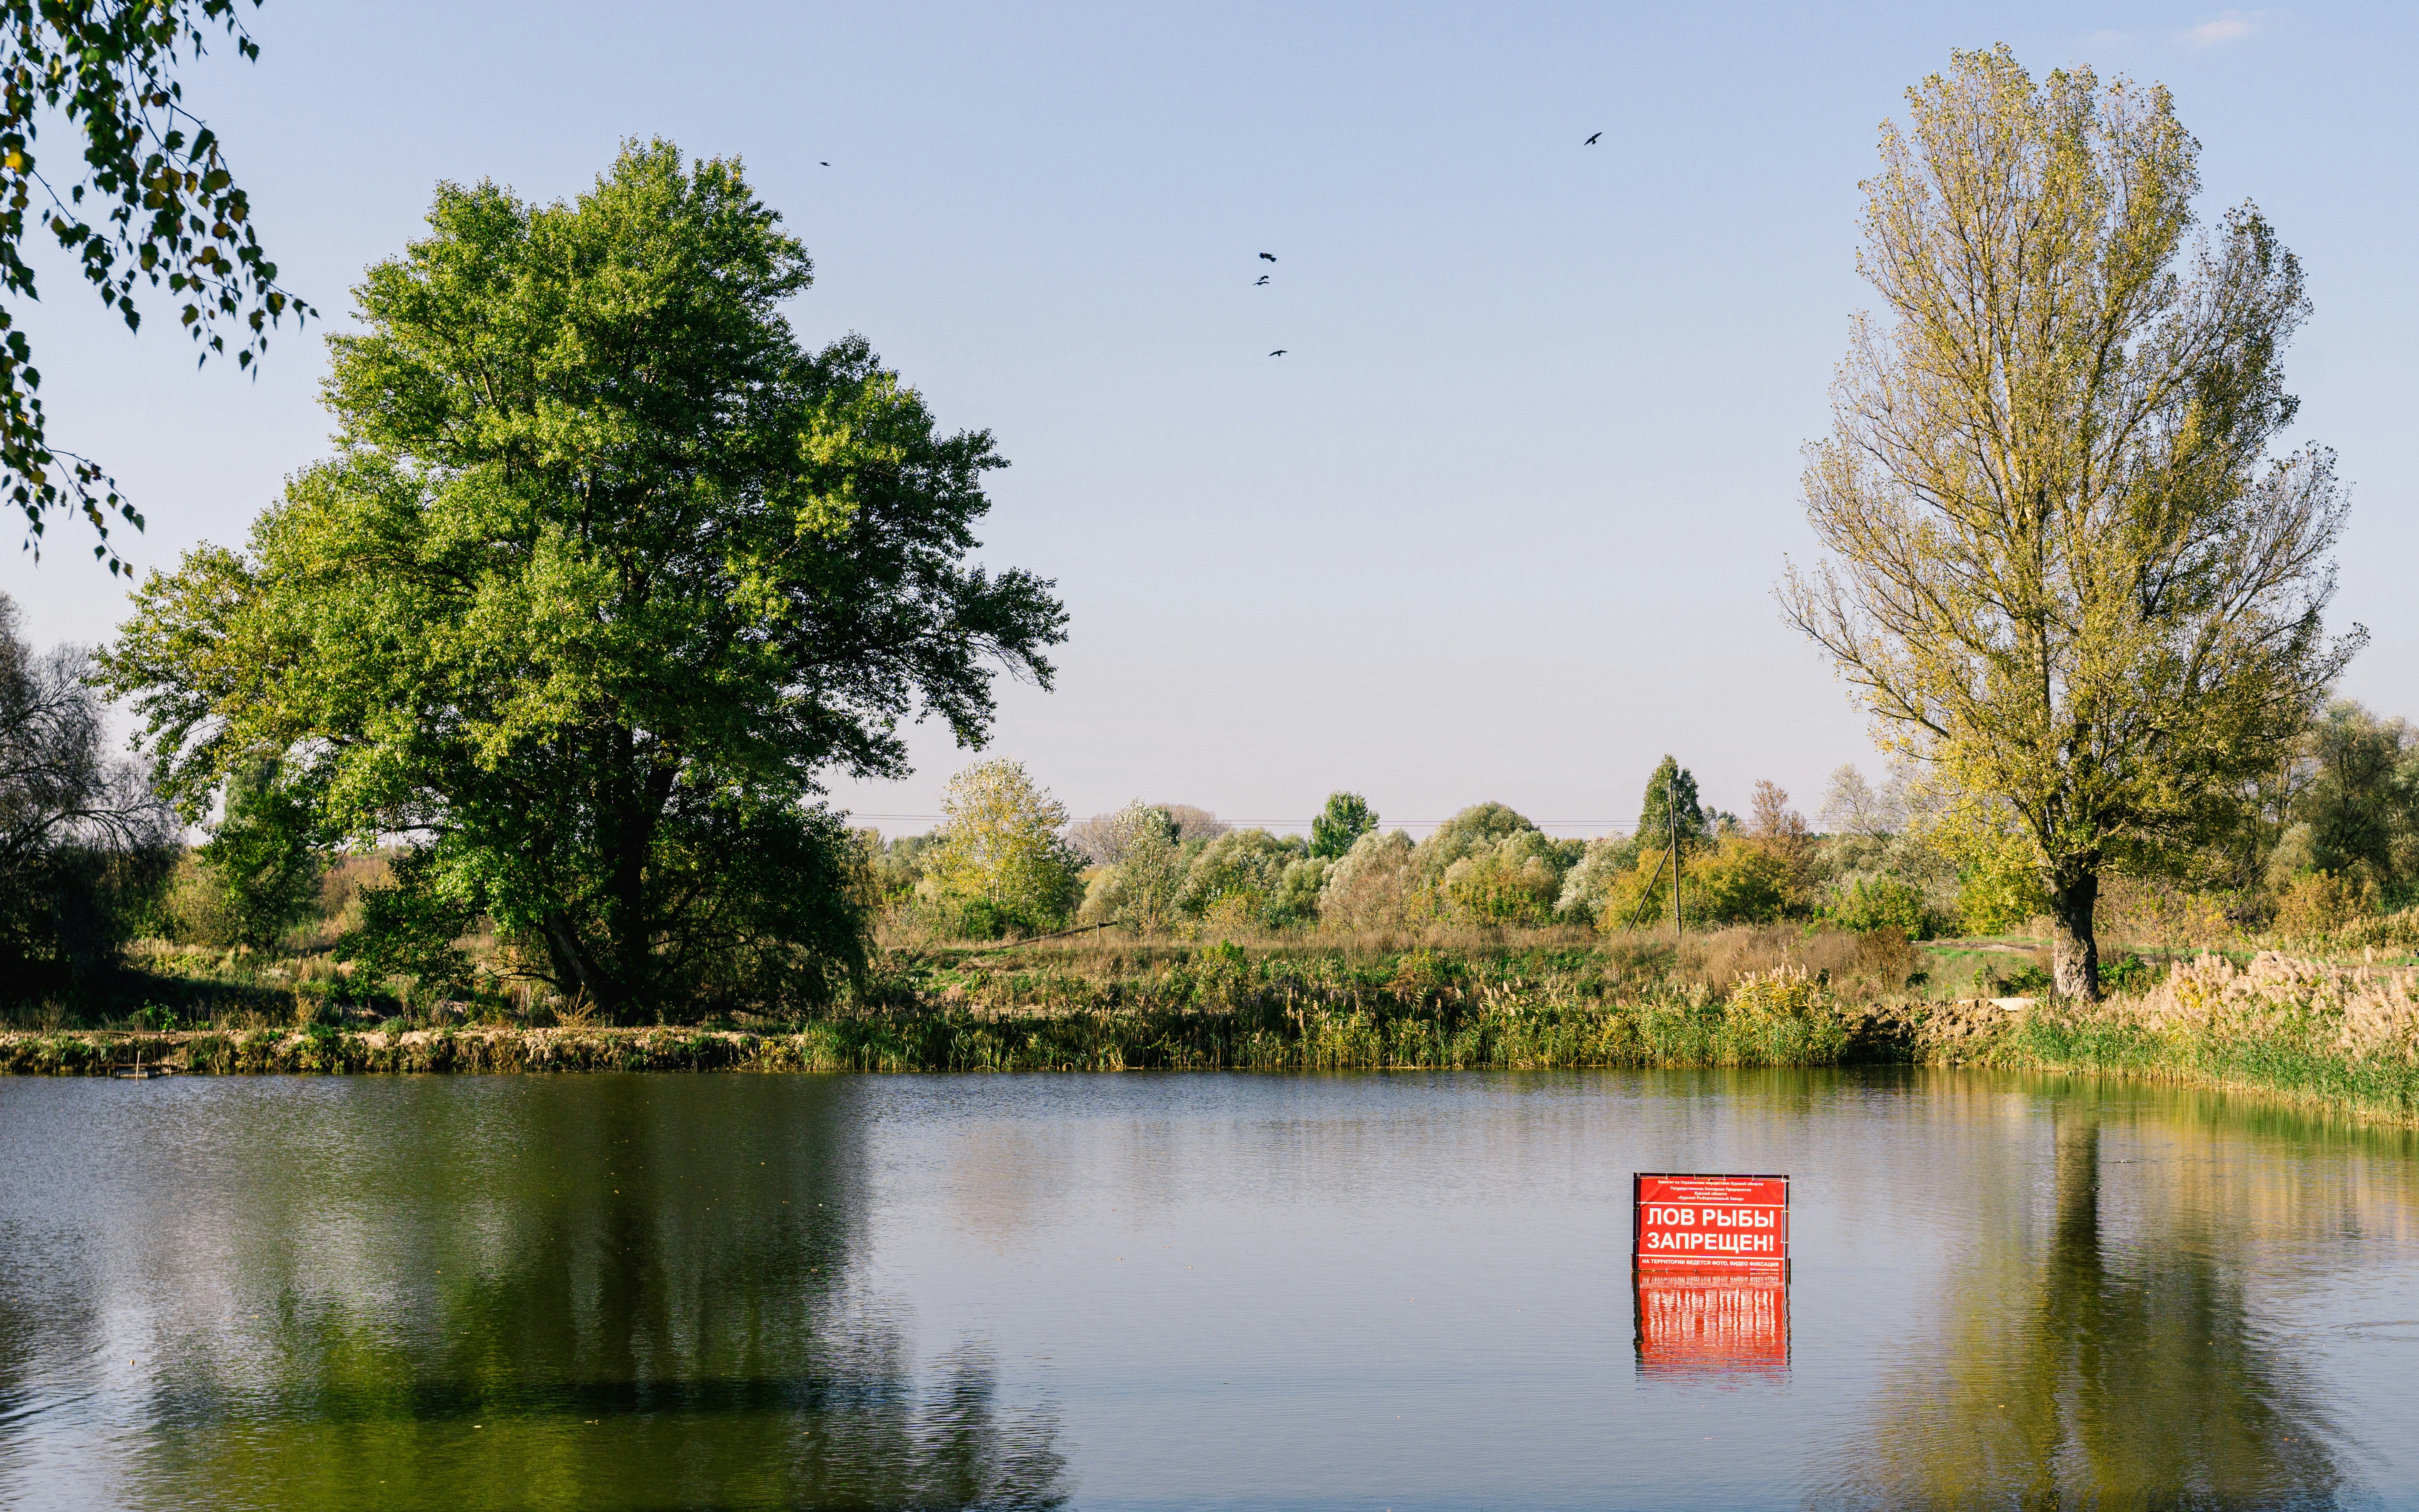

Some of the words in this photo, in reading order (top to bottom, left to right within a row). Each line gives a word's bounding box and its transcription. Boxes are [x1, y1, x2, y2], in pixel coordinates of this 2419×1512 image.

[1647, 1208, 1695, 1225] ЛОВ
[1702, 1209, 1774, 1227] РЫБЫ
[1647, 1232, 1774, 1253] ЗАПРЕЩЕН!
